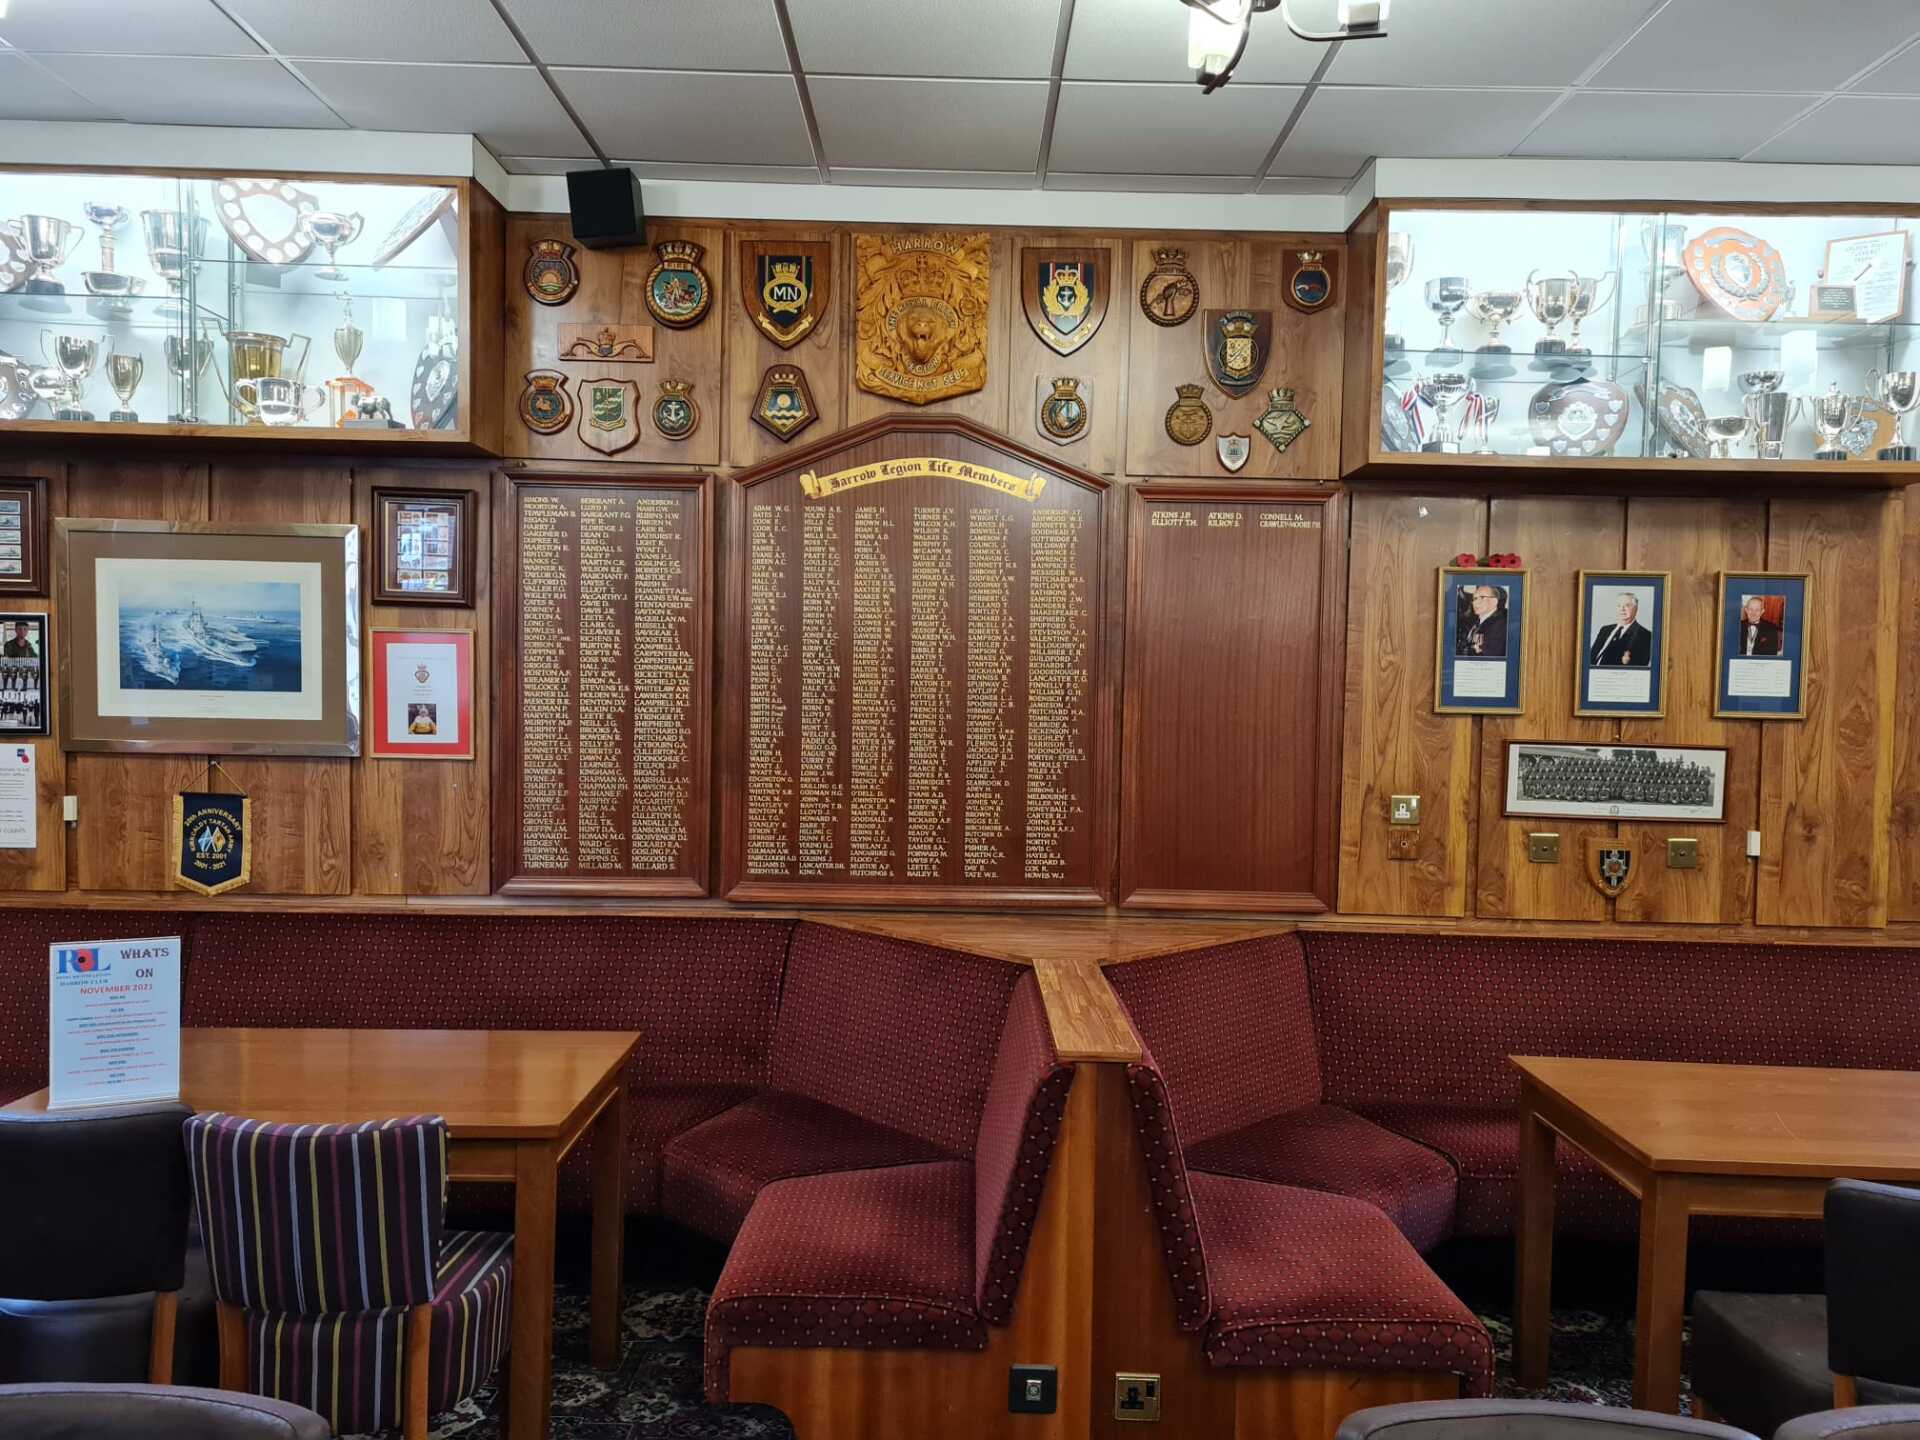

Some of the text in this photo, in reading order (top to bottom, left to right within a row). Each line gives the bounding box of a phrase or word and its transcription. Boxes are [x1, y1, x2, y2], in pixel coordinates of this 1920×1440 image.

[891, 238, 961, 255] HARROW
[773, 287, 798, 300] MN
[830, 460, 1016, 492] Harrow Legion Life Members
[198, 808, 242, 831] ANNIVERSARY
[120, 947, 169, 959] WHATS
[136, 968, 154, 978] ON
[80, 985, 130, 995] NOVEMBER
